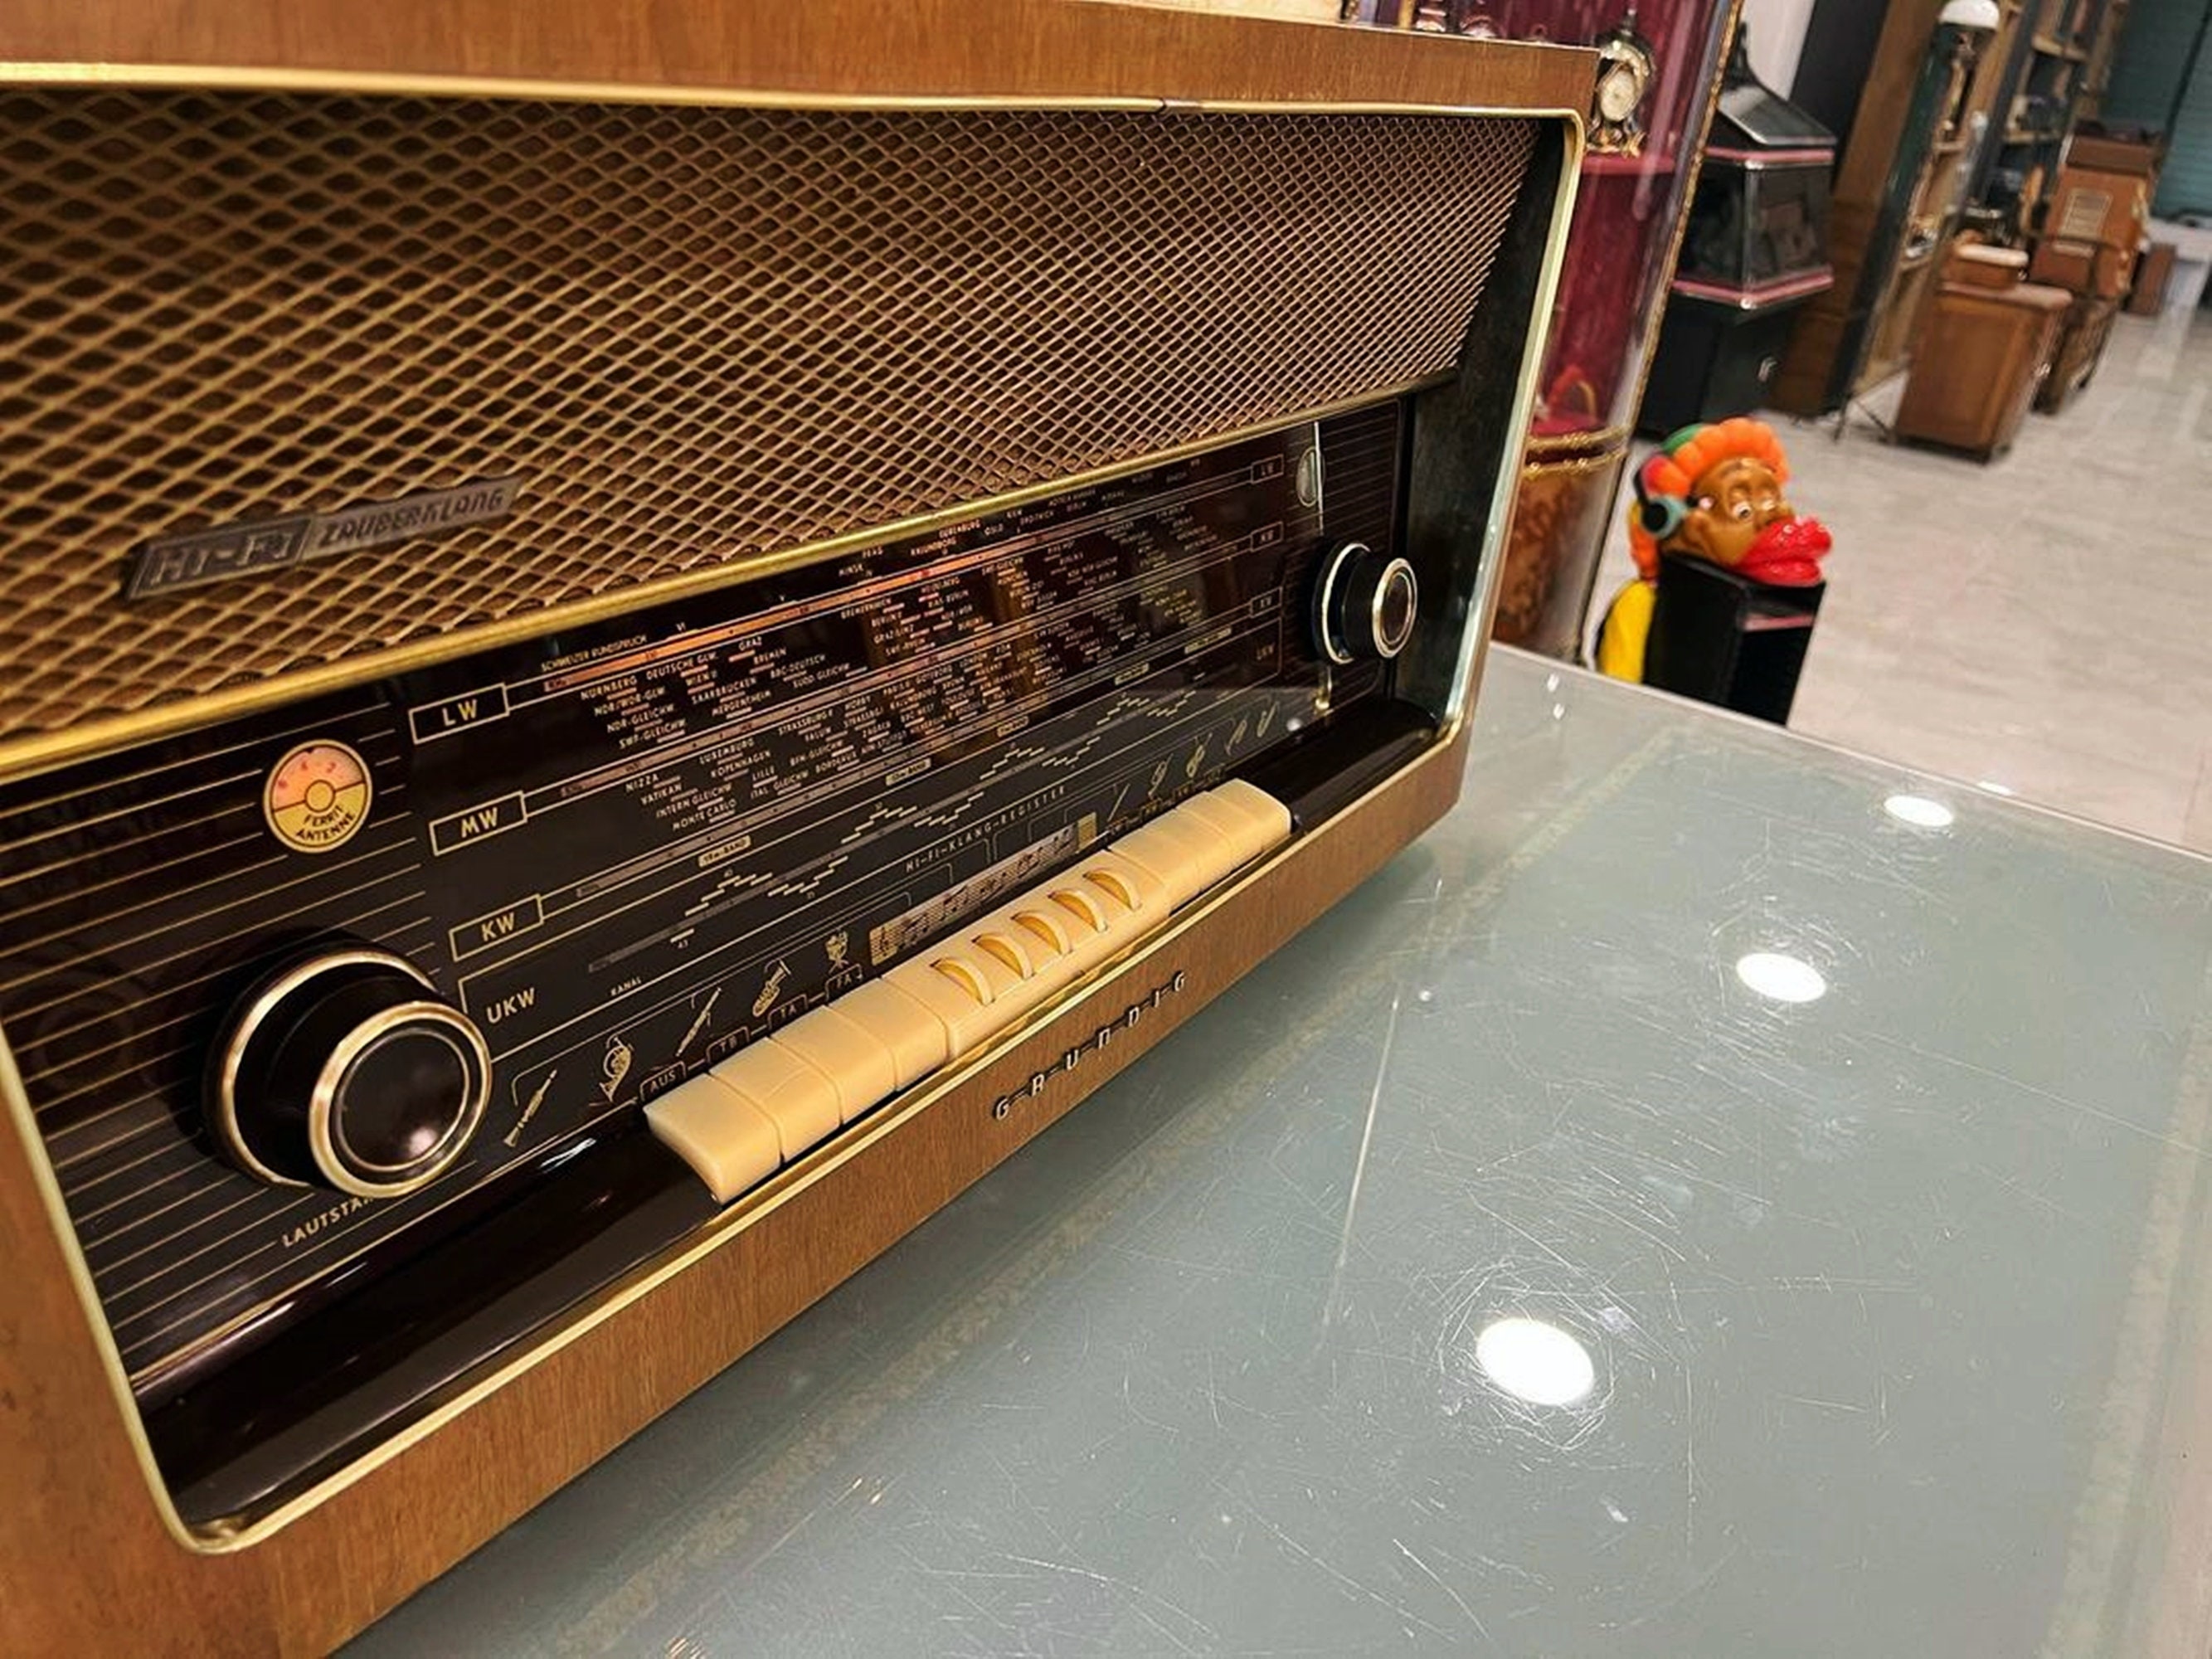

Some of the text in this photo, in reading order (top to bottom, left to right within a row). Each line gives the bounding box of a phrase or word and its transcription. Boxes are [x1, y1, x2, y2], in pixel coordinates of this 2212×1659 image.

[320, 489, 503, 548] ZAUBERKLANG
[753, 648, 787, 664] BREMEN
[646, 661, 694, 680] DEUTSCHE
[442, 699, 478, 727] LW
[711, 750, 772, 778] KOPENHAGEN
[752, 765, 775, 781] LILLE
[625, 774, 659, 792] NIZZA
[641, 782, 683, 805] VATIKAN
[295, 811, 356, 841] ANTENNE
[460, 807, 498, 838] MW
[673, 798, 737, 830] MONTE CARLO
[481, 912, 516, 941] KW
[610, 976, 642, 996] KANAL
[487, 988, 535, 1024] UKW
[780, 1004, 797, 1019] TA
[650, 1071, 676, 1093] AUS
